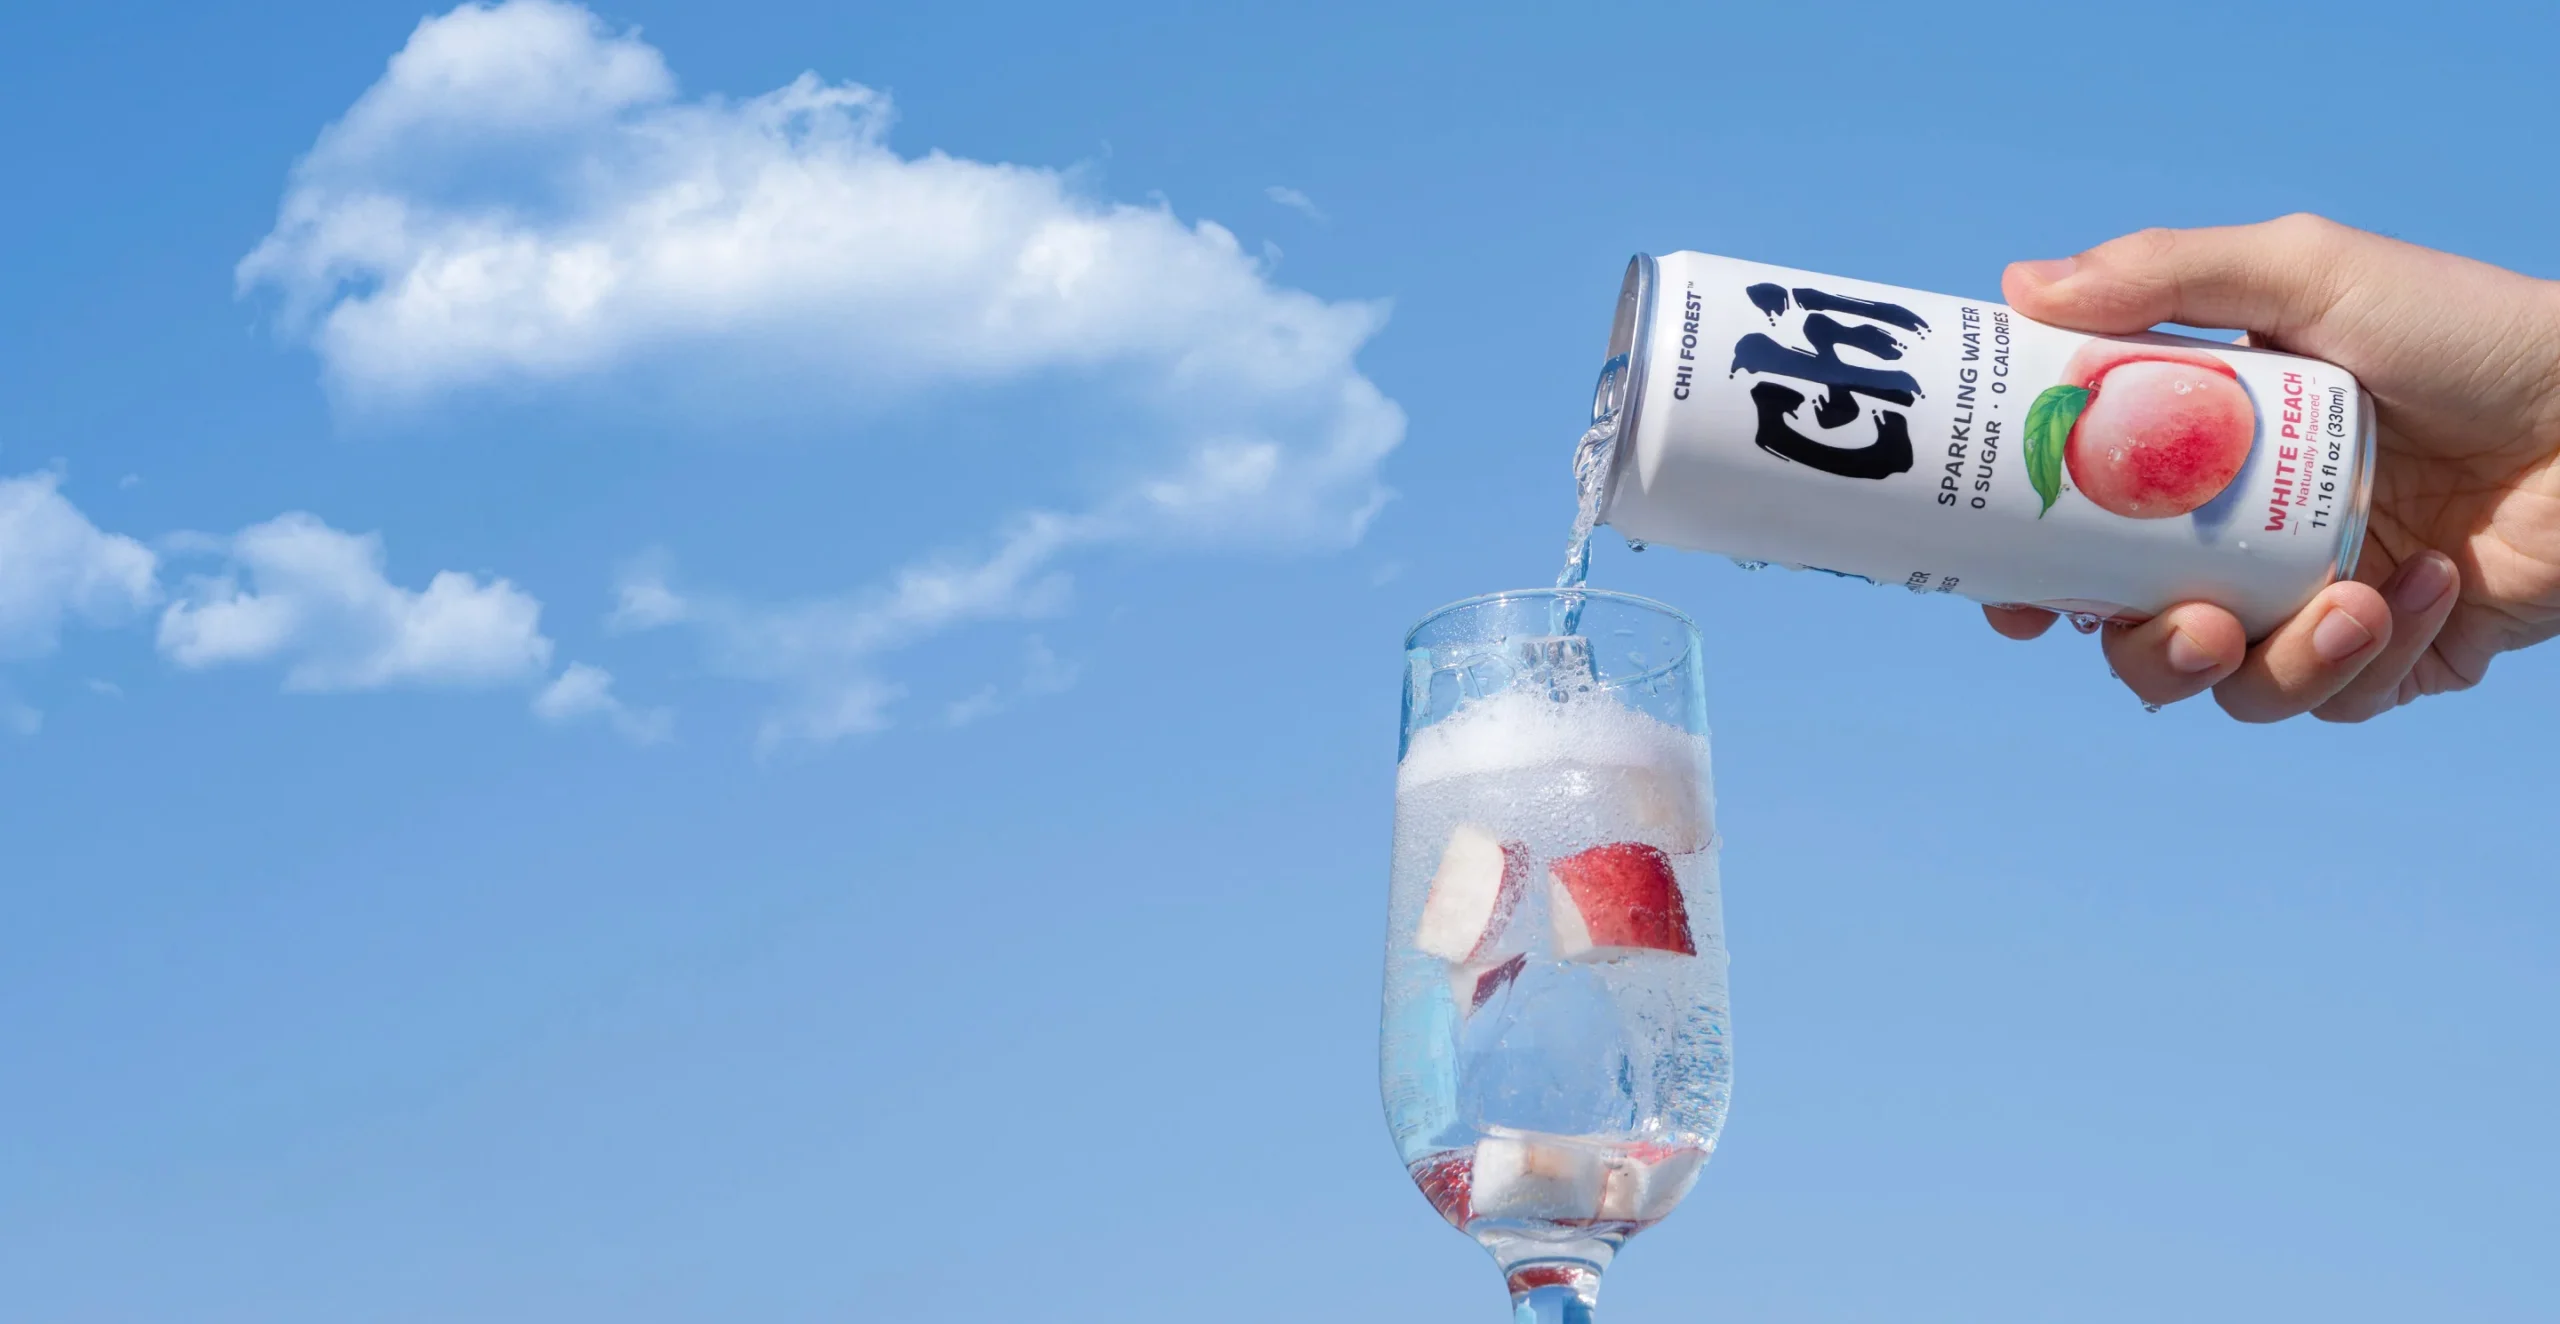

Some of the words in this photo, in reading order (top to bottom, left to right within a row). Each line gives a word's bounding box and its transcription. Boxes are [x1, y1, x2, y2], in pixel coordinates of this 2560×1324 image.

[1673, 365, 1694, 401] CHI
[1937, 368, 1978, 507] SPARKLING
[1961, 306, 1981, 362] WATER
[1975, 420, 2002, 492] SUGAR
[1993, 311, 2010, 377] CALORIES
[2306, 393, 2321, 443] Flavored
[2326, 386, 2348, 438] (330ml)
[2264, 444, 2298, 532] WHITE
[2281, 371, 2303, 440] PEACH
[2322, 464, 2338, 477] fl
[2328, 441, 2341, 461] oz
[2295, 447, 2320, 507] Naturally
[2312, 481, 2334, 529] 11.16
